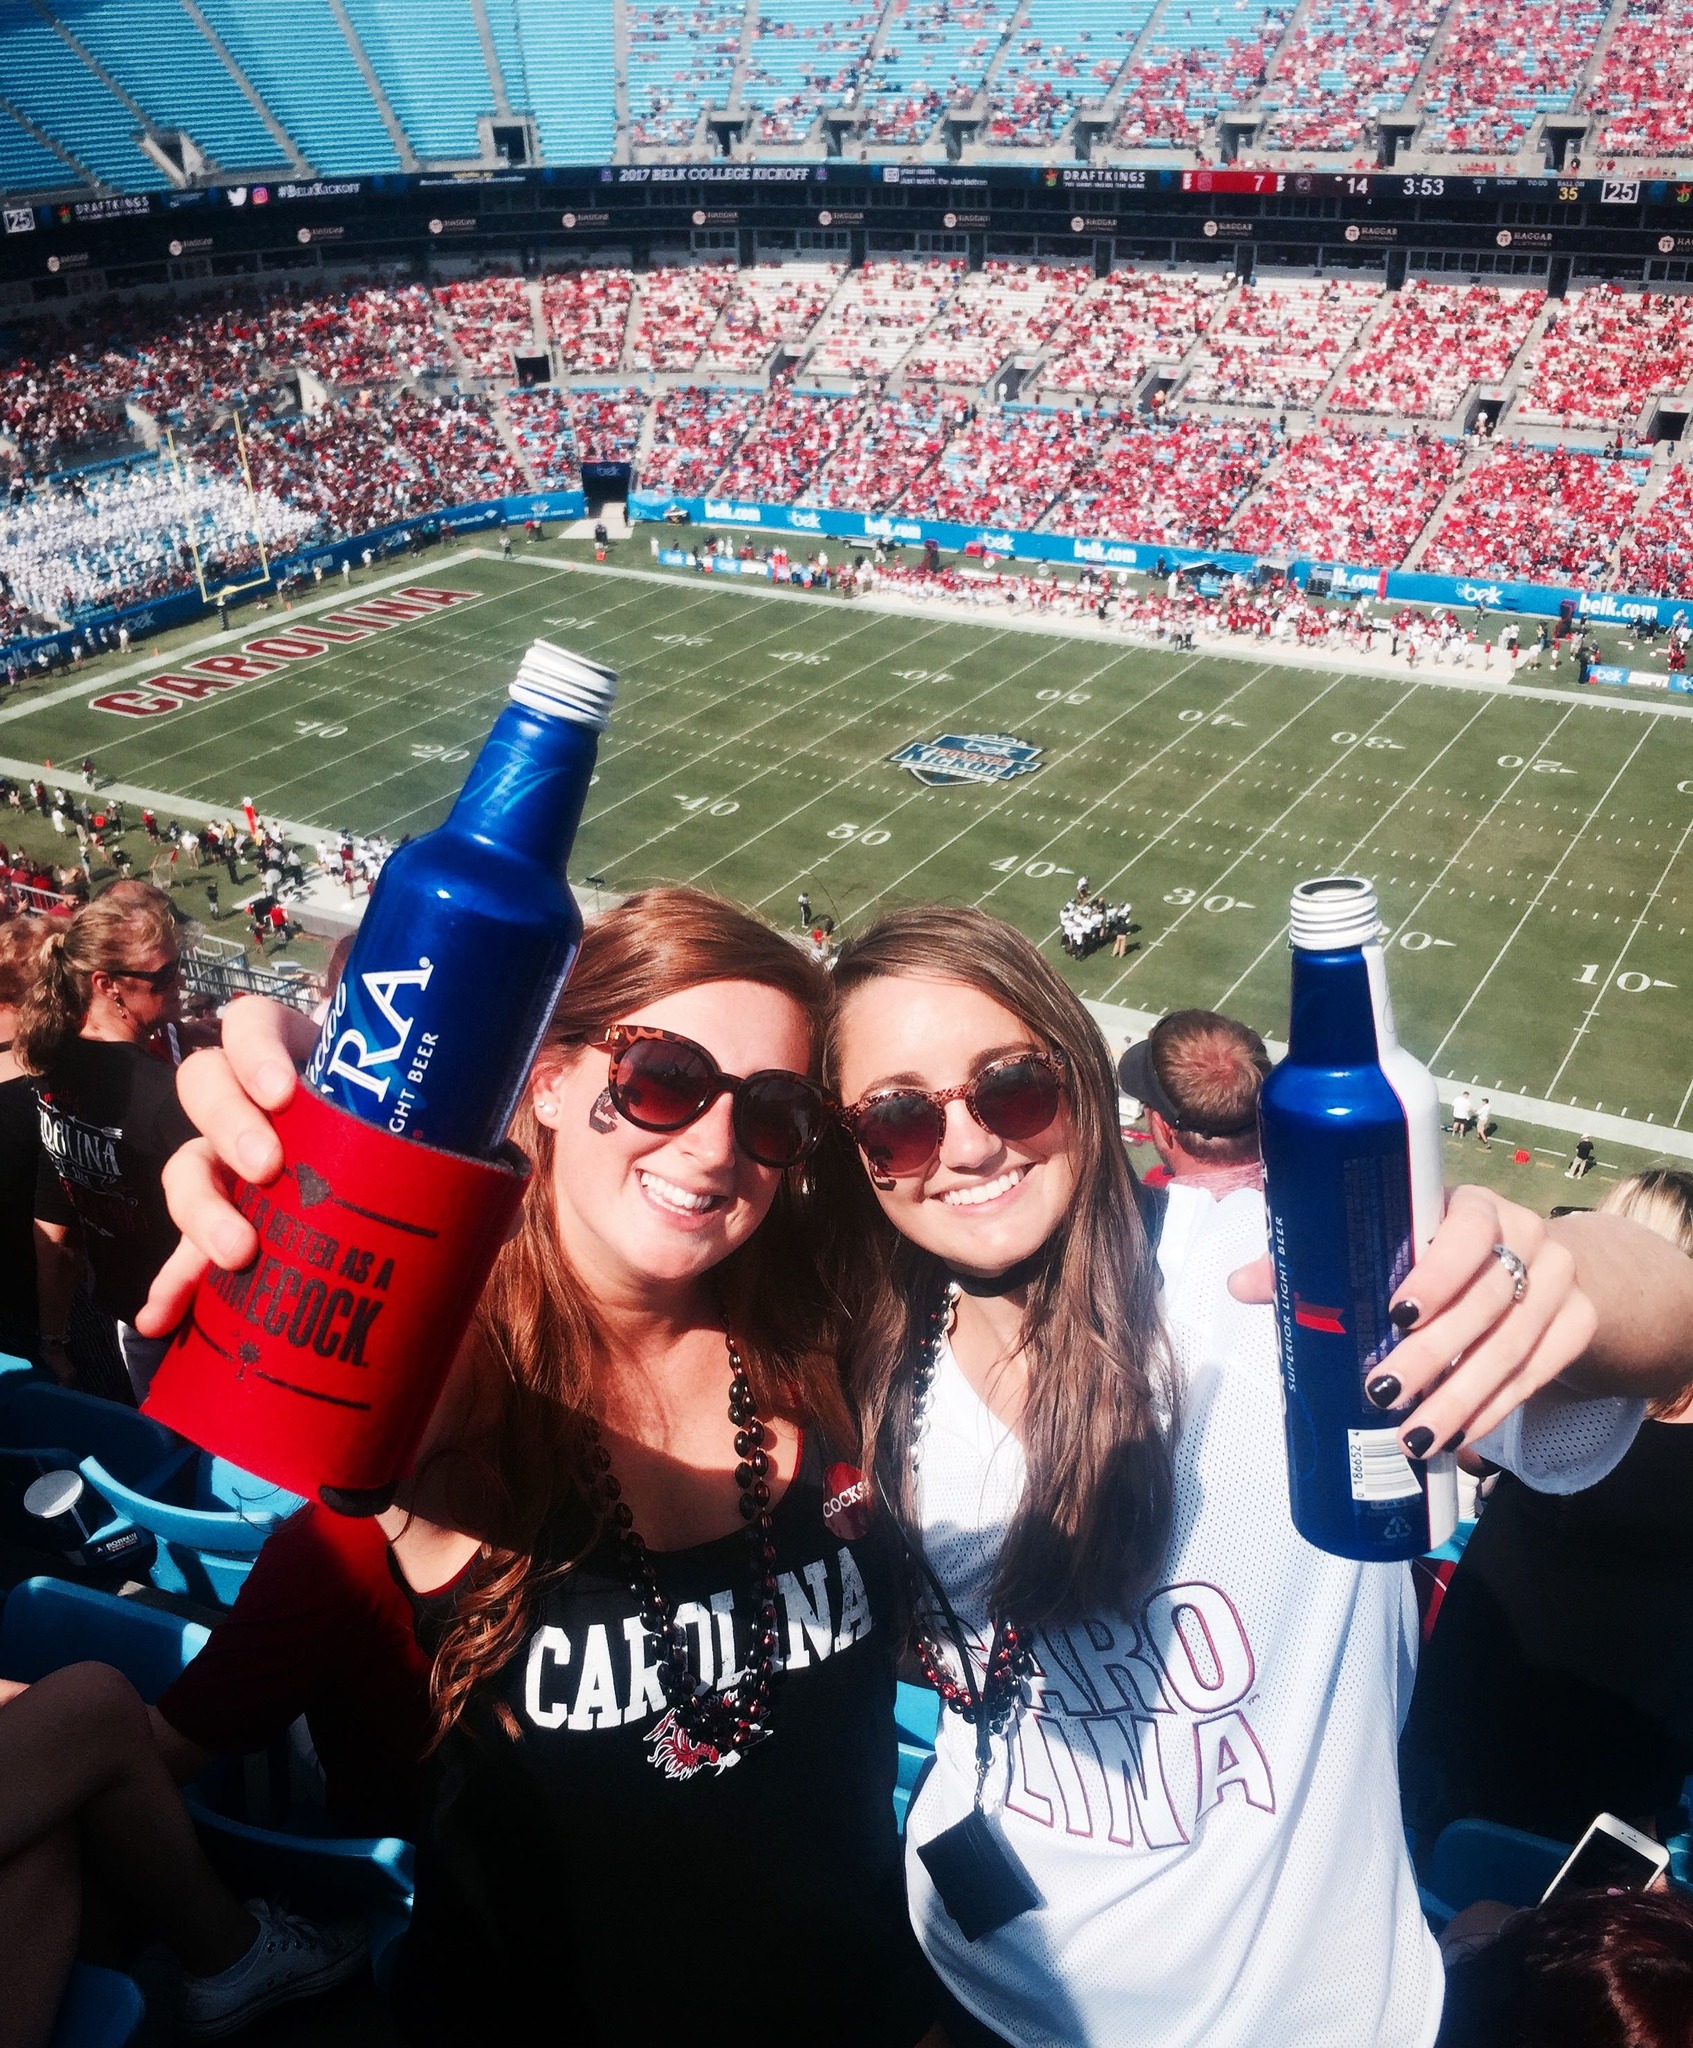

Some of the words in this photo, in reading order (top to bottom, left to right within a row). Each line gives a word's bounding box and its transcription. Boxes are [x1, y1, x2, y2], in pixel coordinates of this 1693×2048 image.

[619, 169, 651, 182] 2017
[652, 168, 687, 182] BELK
[688, 168, 751, 181] COLLEGE
[752, 168, 810, 181] KICKOFF
[1063, 170, 1146, 184] DRAFTKINGS
[1254, 175, 1265, 192] 7
[1346, 178, 1368, 195] 14
[1402, 178, 1445, 196] 3:53
[1558, 187, 1579, 201] 35
[1607, 182, 1634, 201] 25
[75, 196, 150, 215] DRAFTKINGS
[10, 213, 31, 230] 25
[1361, 227, 1398, 236] HAGGAR
[1513, 231, 1552, 241] HAGGAR
[1073, 540, 1137, 564] belk.com
[1463, 582, 1503, 605] belk
[1579, 594, 1659, 620] belk.com
[88, 585, 484, 719] CAROLINA
[963, 741, 1018, 758] belk
[892, 743, 1041, 780] KICKOFF
[680, 796, 740, 817] 40
[826, 823, 892, 846] 50
[988, 855, 1056, 879] 40
[1162, 887, 1236, 913] 30
[1572, 963, 1651, 993] 10
[388, 1087, 416, 1133] GHT
[407, 1031, 439, 1083] BEER
[1275, 1216, 1287, 1257] BEER
[266, 1207, 340, 1271] BETTER
[338, 1245, 376, 1283] AS
[372, 1257, 395, 1292] A
[1278, 1259, 1291, 1311] LIGHT
[1282, 1314, 1297, 1393] SUPERIOR
[1350, 1444, 1364, 1485] 186652
[524, 1546, 873, 1732] CAROLNA
[1003, 1708, 1276, 1851] LINA
